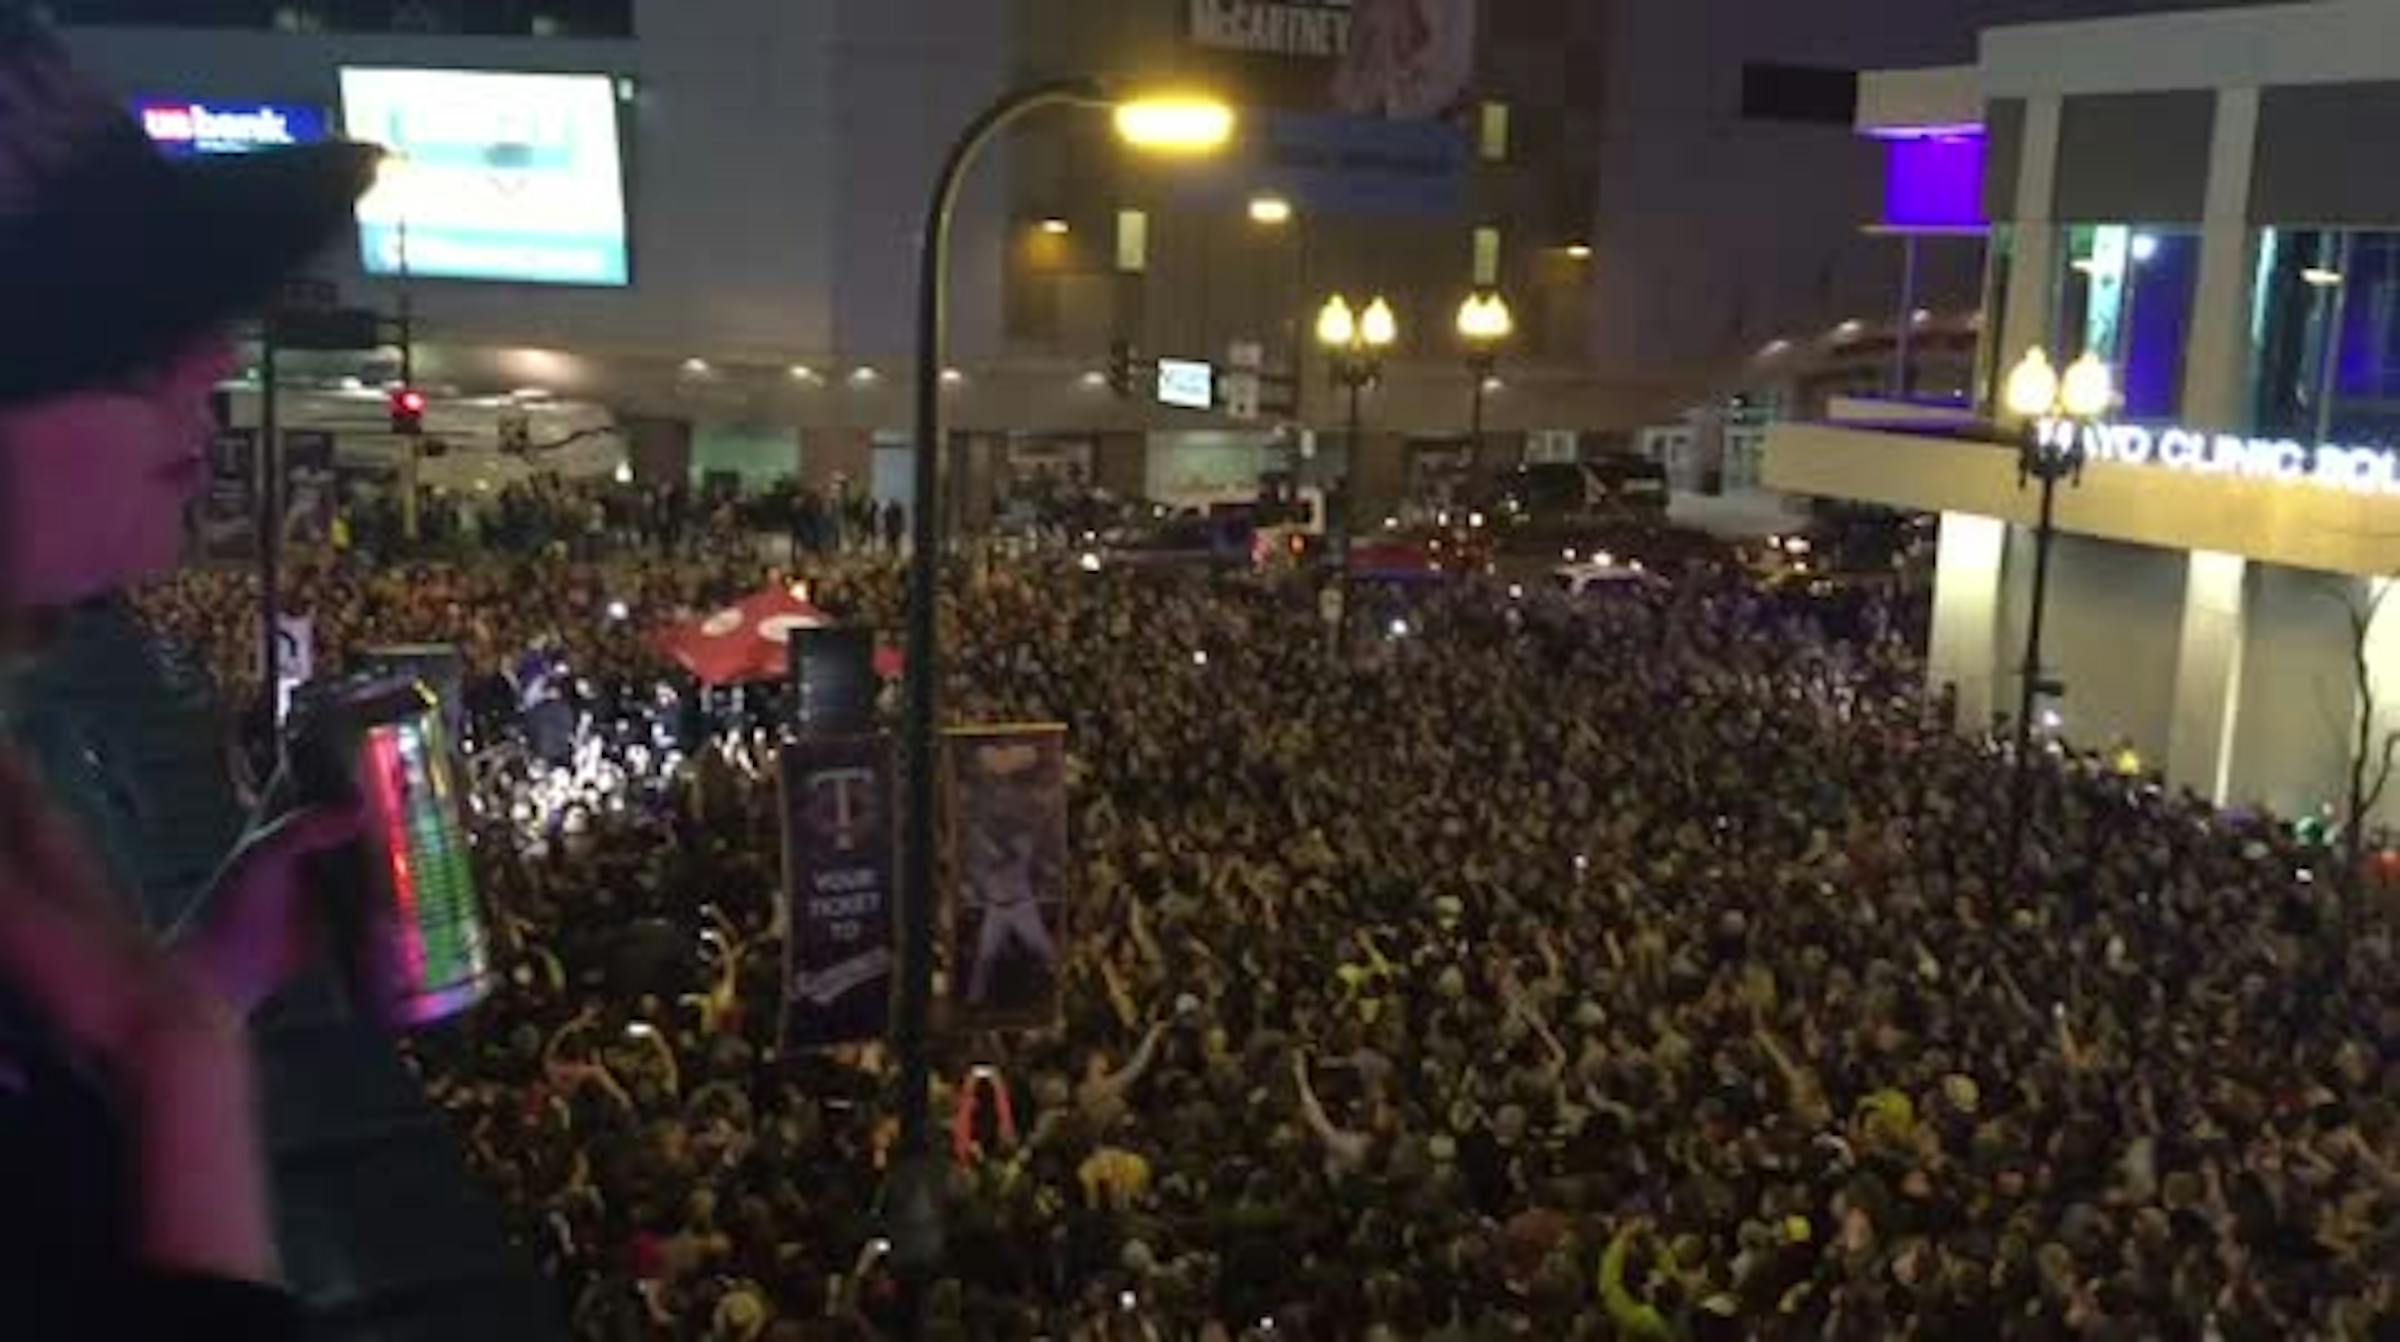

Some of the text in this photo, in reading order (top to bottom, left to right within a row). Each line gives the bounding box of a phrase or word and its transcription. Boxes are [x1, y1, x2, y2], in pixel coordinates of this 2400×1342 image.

[2158, 427, 2304, 483] CLINIC
[811, 868, 877, 893] YOUR
[810, 892, 882, 918] TICKET
[829, 919, 861, 941] TO
